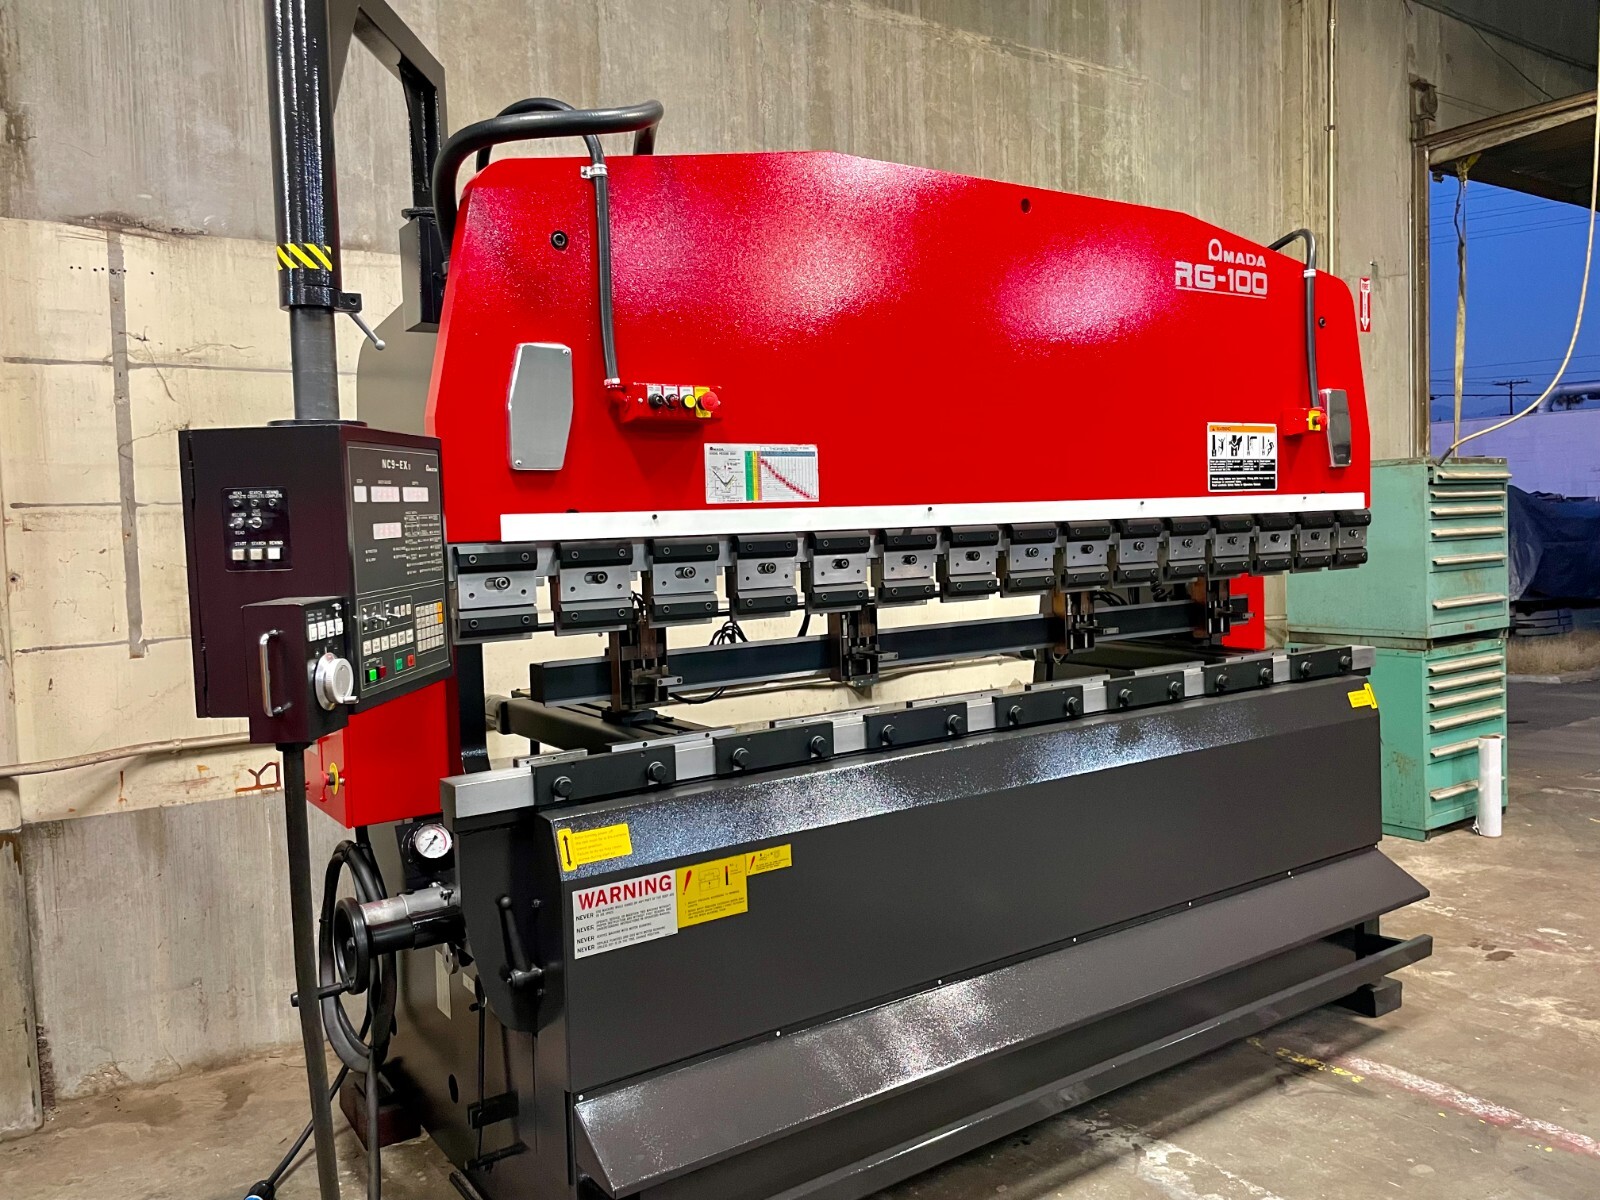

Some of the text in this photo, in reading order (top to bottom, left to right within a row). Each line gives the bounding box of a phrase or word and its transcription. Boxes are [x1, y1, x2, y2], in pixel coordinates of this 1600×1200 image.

[1207, 238, 1267, 269] AMADA
[1174, 260, 1268, 295] RG-100
[578, 874, 672, 911] WARNING
[575, 912, 594, 922] NEVER
[576, 924, 595, 934] NEVER
[576, 935, 595, 945] NEVER
[577, 944, 595, 954] NEVER
